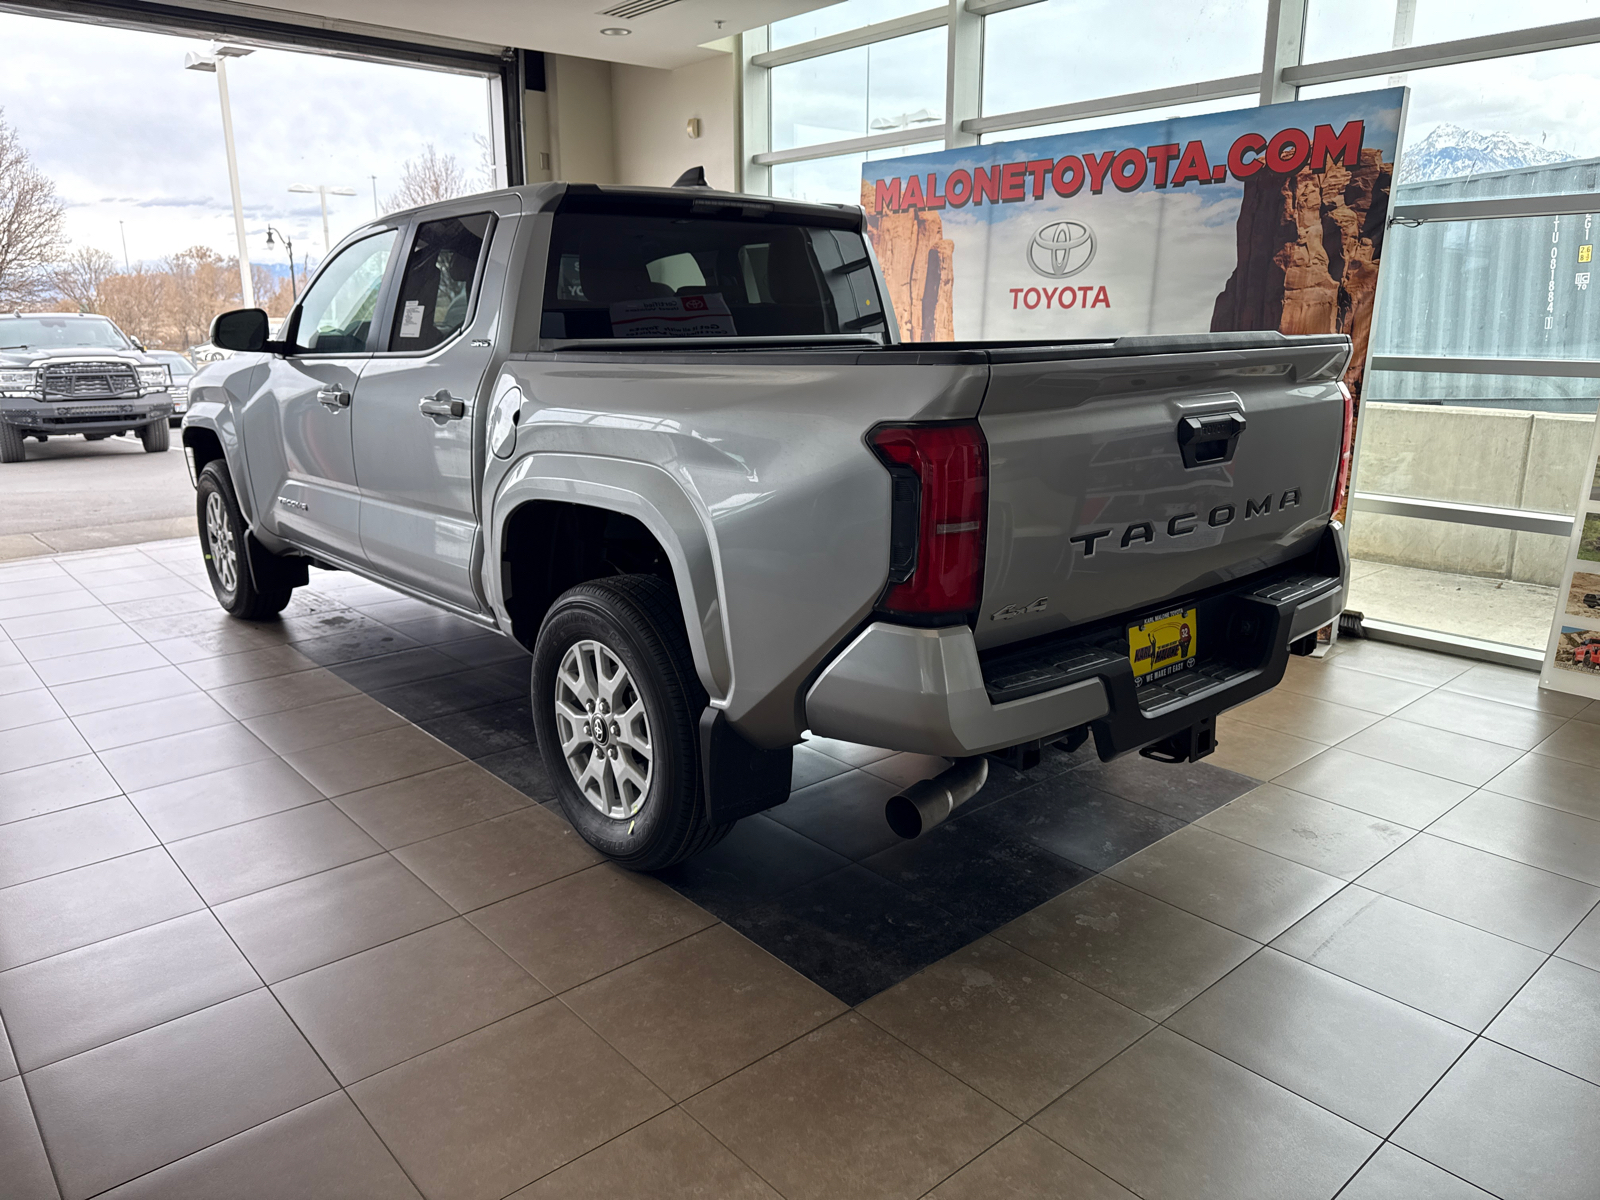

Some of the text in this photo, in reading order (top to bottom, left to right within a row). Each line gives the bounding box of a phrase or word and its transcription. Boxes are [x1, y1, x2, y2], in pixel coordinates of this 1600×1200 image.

[873, 118, 1365, 215] MALONETOYOTA.COM
[1546, 247, 1558, 314] 081884
[1009, 284, 1111, 311] TOYOTA
[1069, 485, 1303, 560] TACOMA
[1155, 612, 1170, 621] MALONE
[1170, 608, 1183, 617] TOYOTA
[1181, 627, 1189, 638] 32
[1146, 662, 1184, 682] WE MAKE IT EASY
